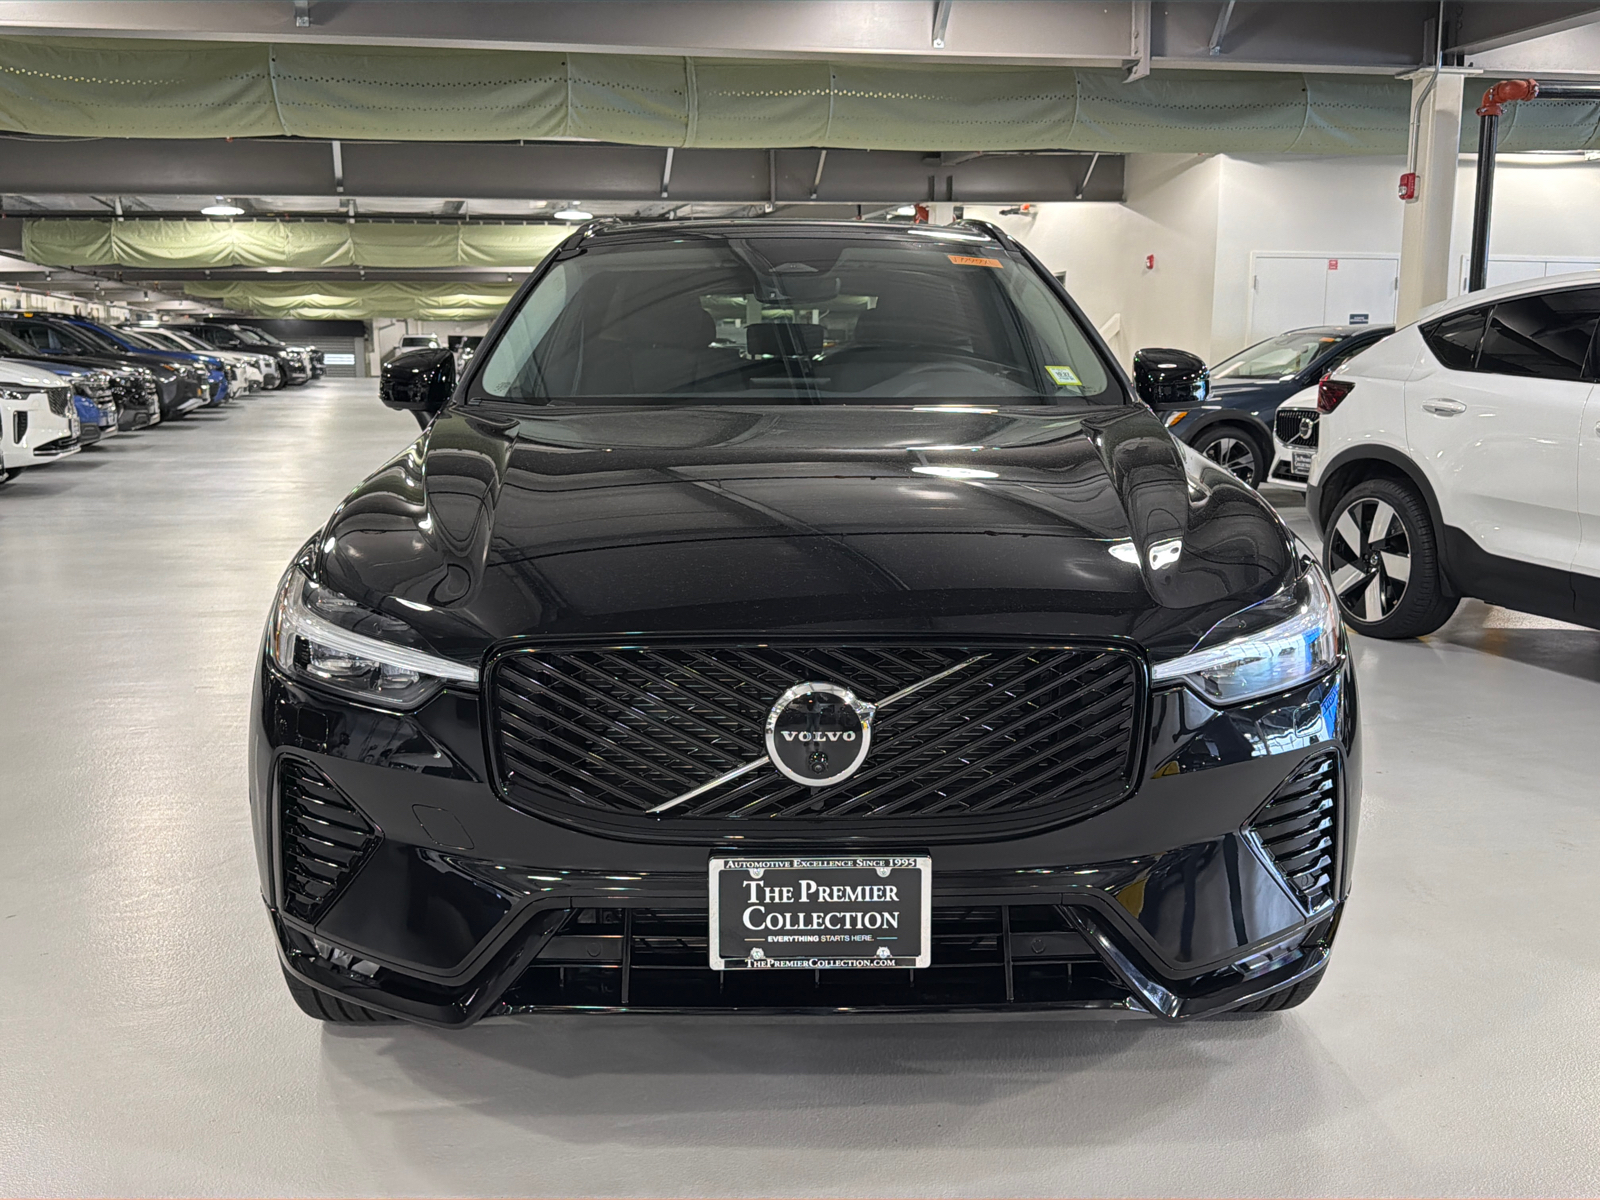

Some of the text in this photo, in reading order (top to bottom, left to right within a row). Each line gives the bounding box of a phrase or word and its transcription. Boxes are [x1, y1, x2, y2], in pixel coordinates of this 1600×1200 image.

[780, 730, 856, 742] VOLVO
[726, 858, 915, 869] AUTOMOTIVE EXCELLENCE SINCE 1995
[742, 879, 899, 903] THE PREMIER
[742, 905, 900, 930] COLLECTION
[820, 934, 850, 942] STARTS
[851, 934, 874, 942] HERE.
